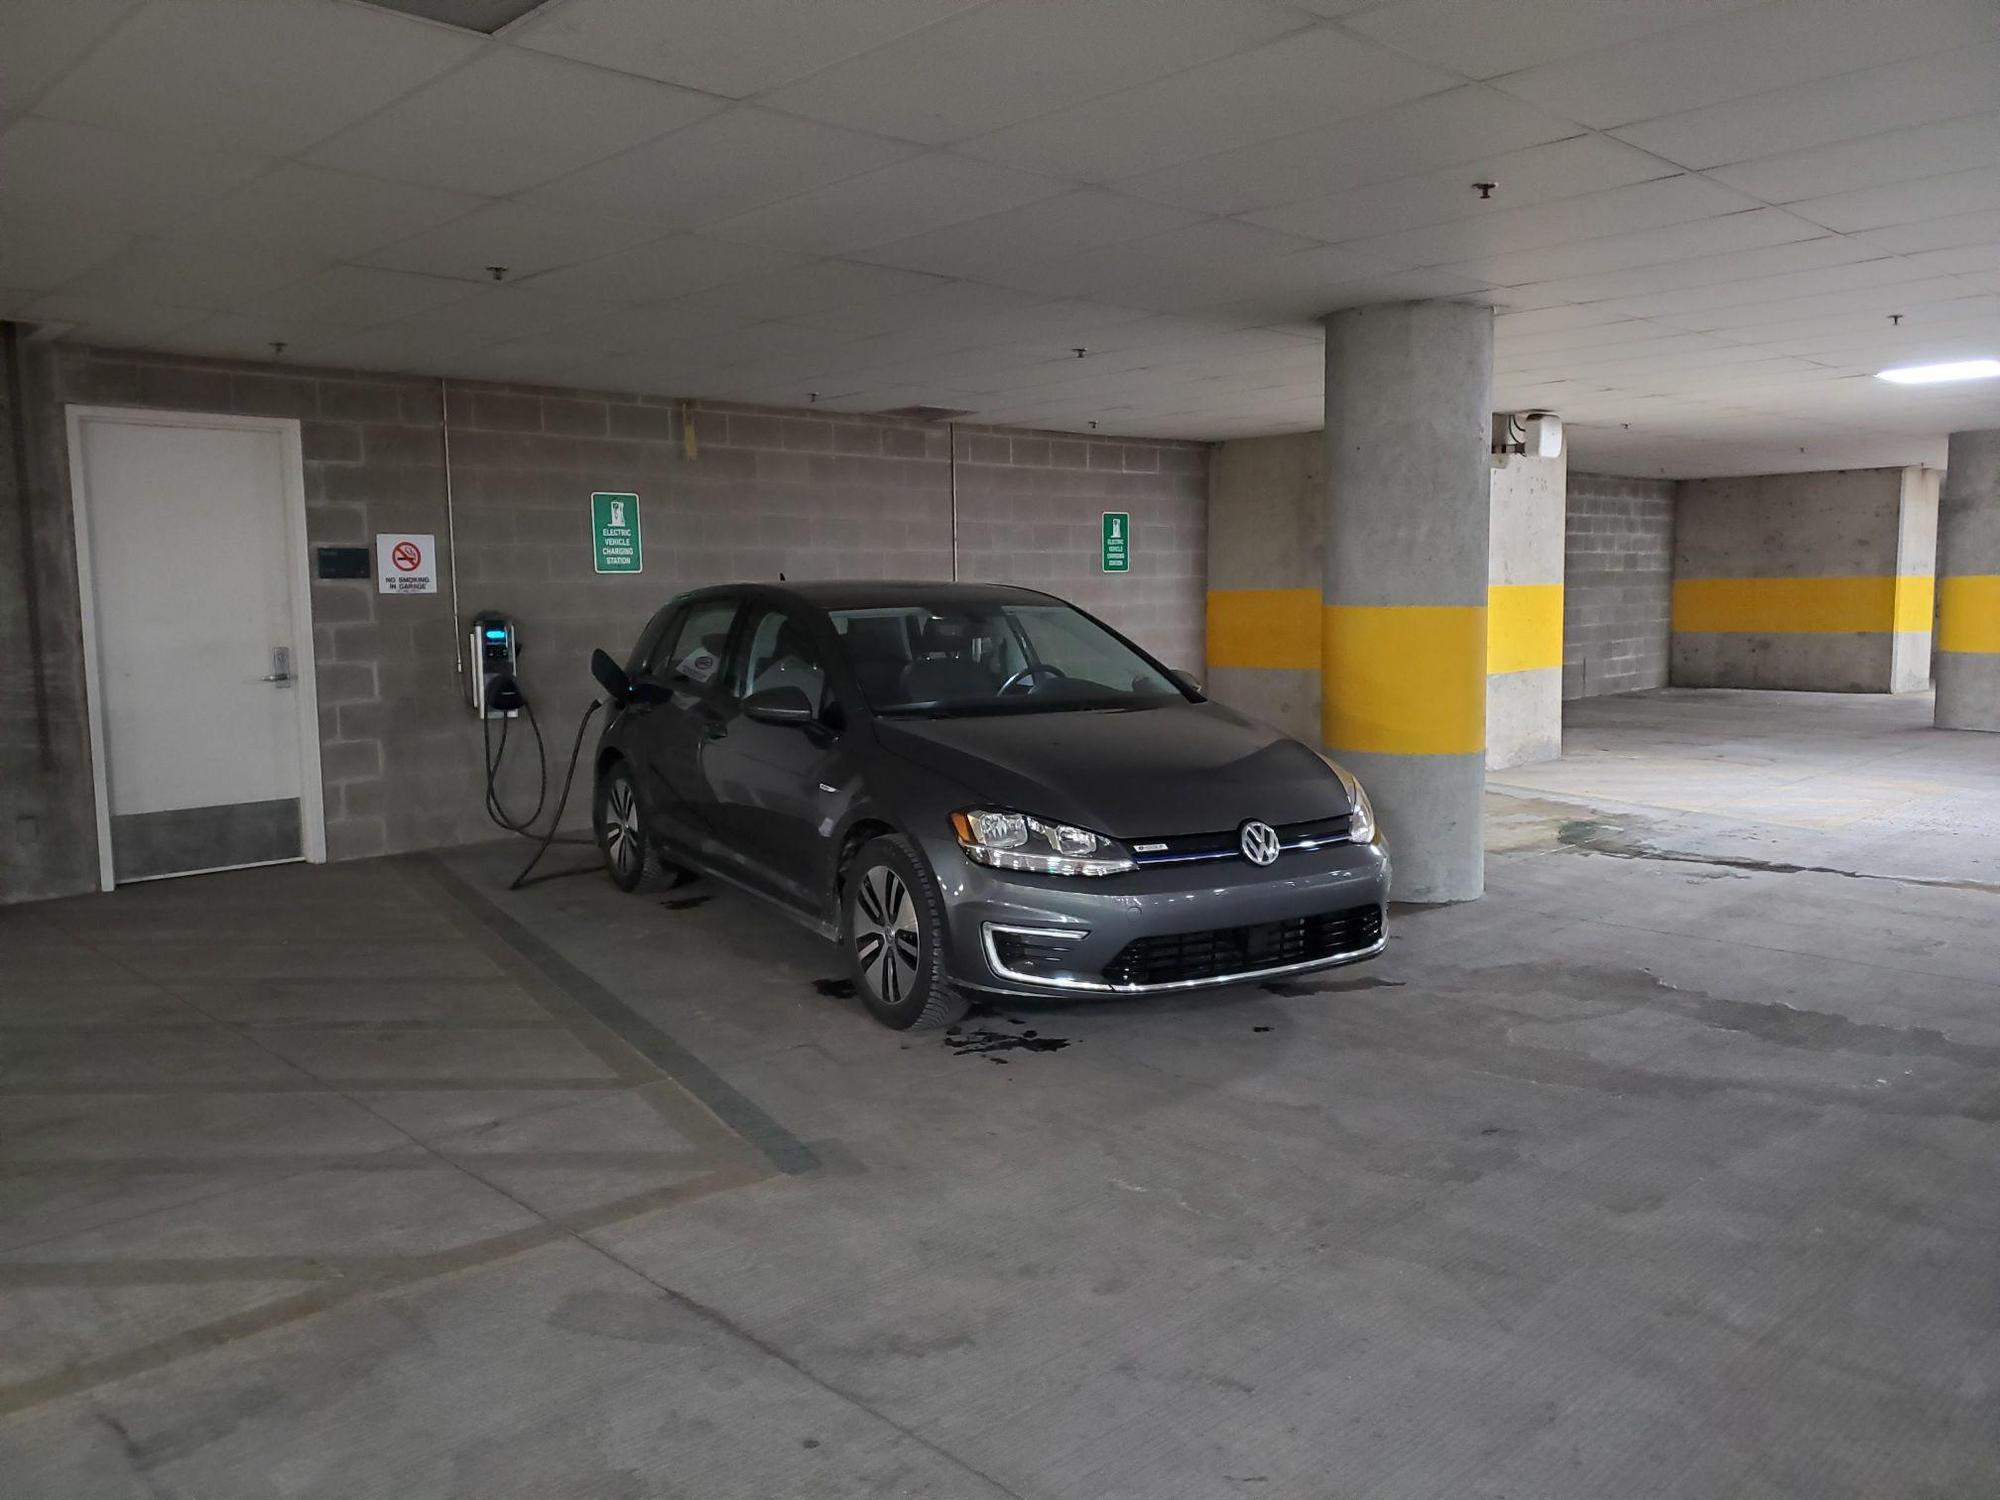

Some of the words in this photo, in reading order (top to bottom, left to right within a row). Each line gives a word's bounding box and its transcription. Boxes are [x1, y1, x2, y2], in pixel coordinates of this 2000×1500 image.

[602, 528, 631, 536] ELECTRIC
[605, 538, 630, 546] VEHICLE
[602, 547, 633, 555] CHARGING
